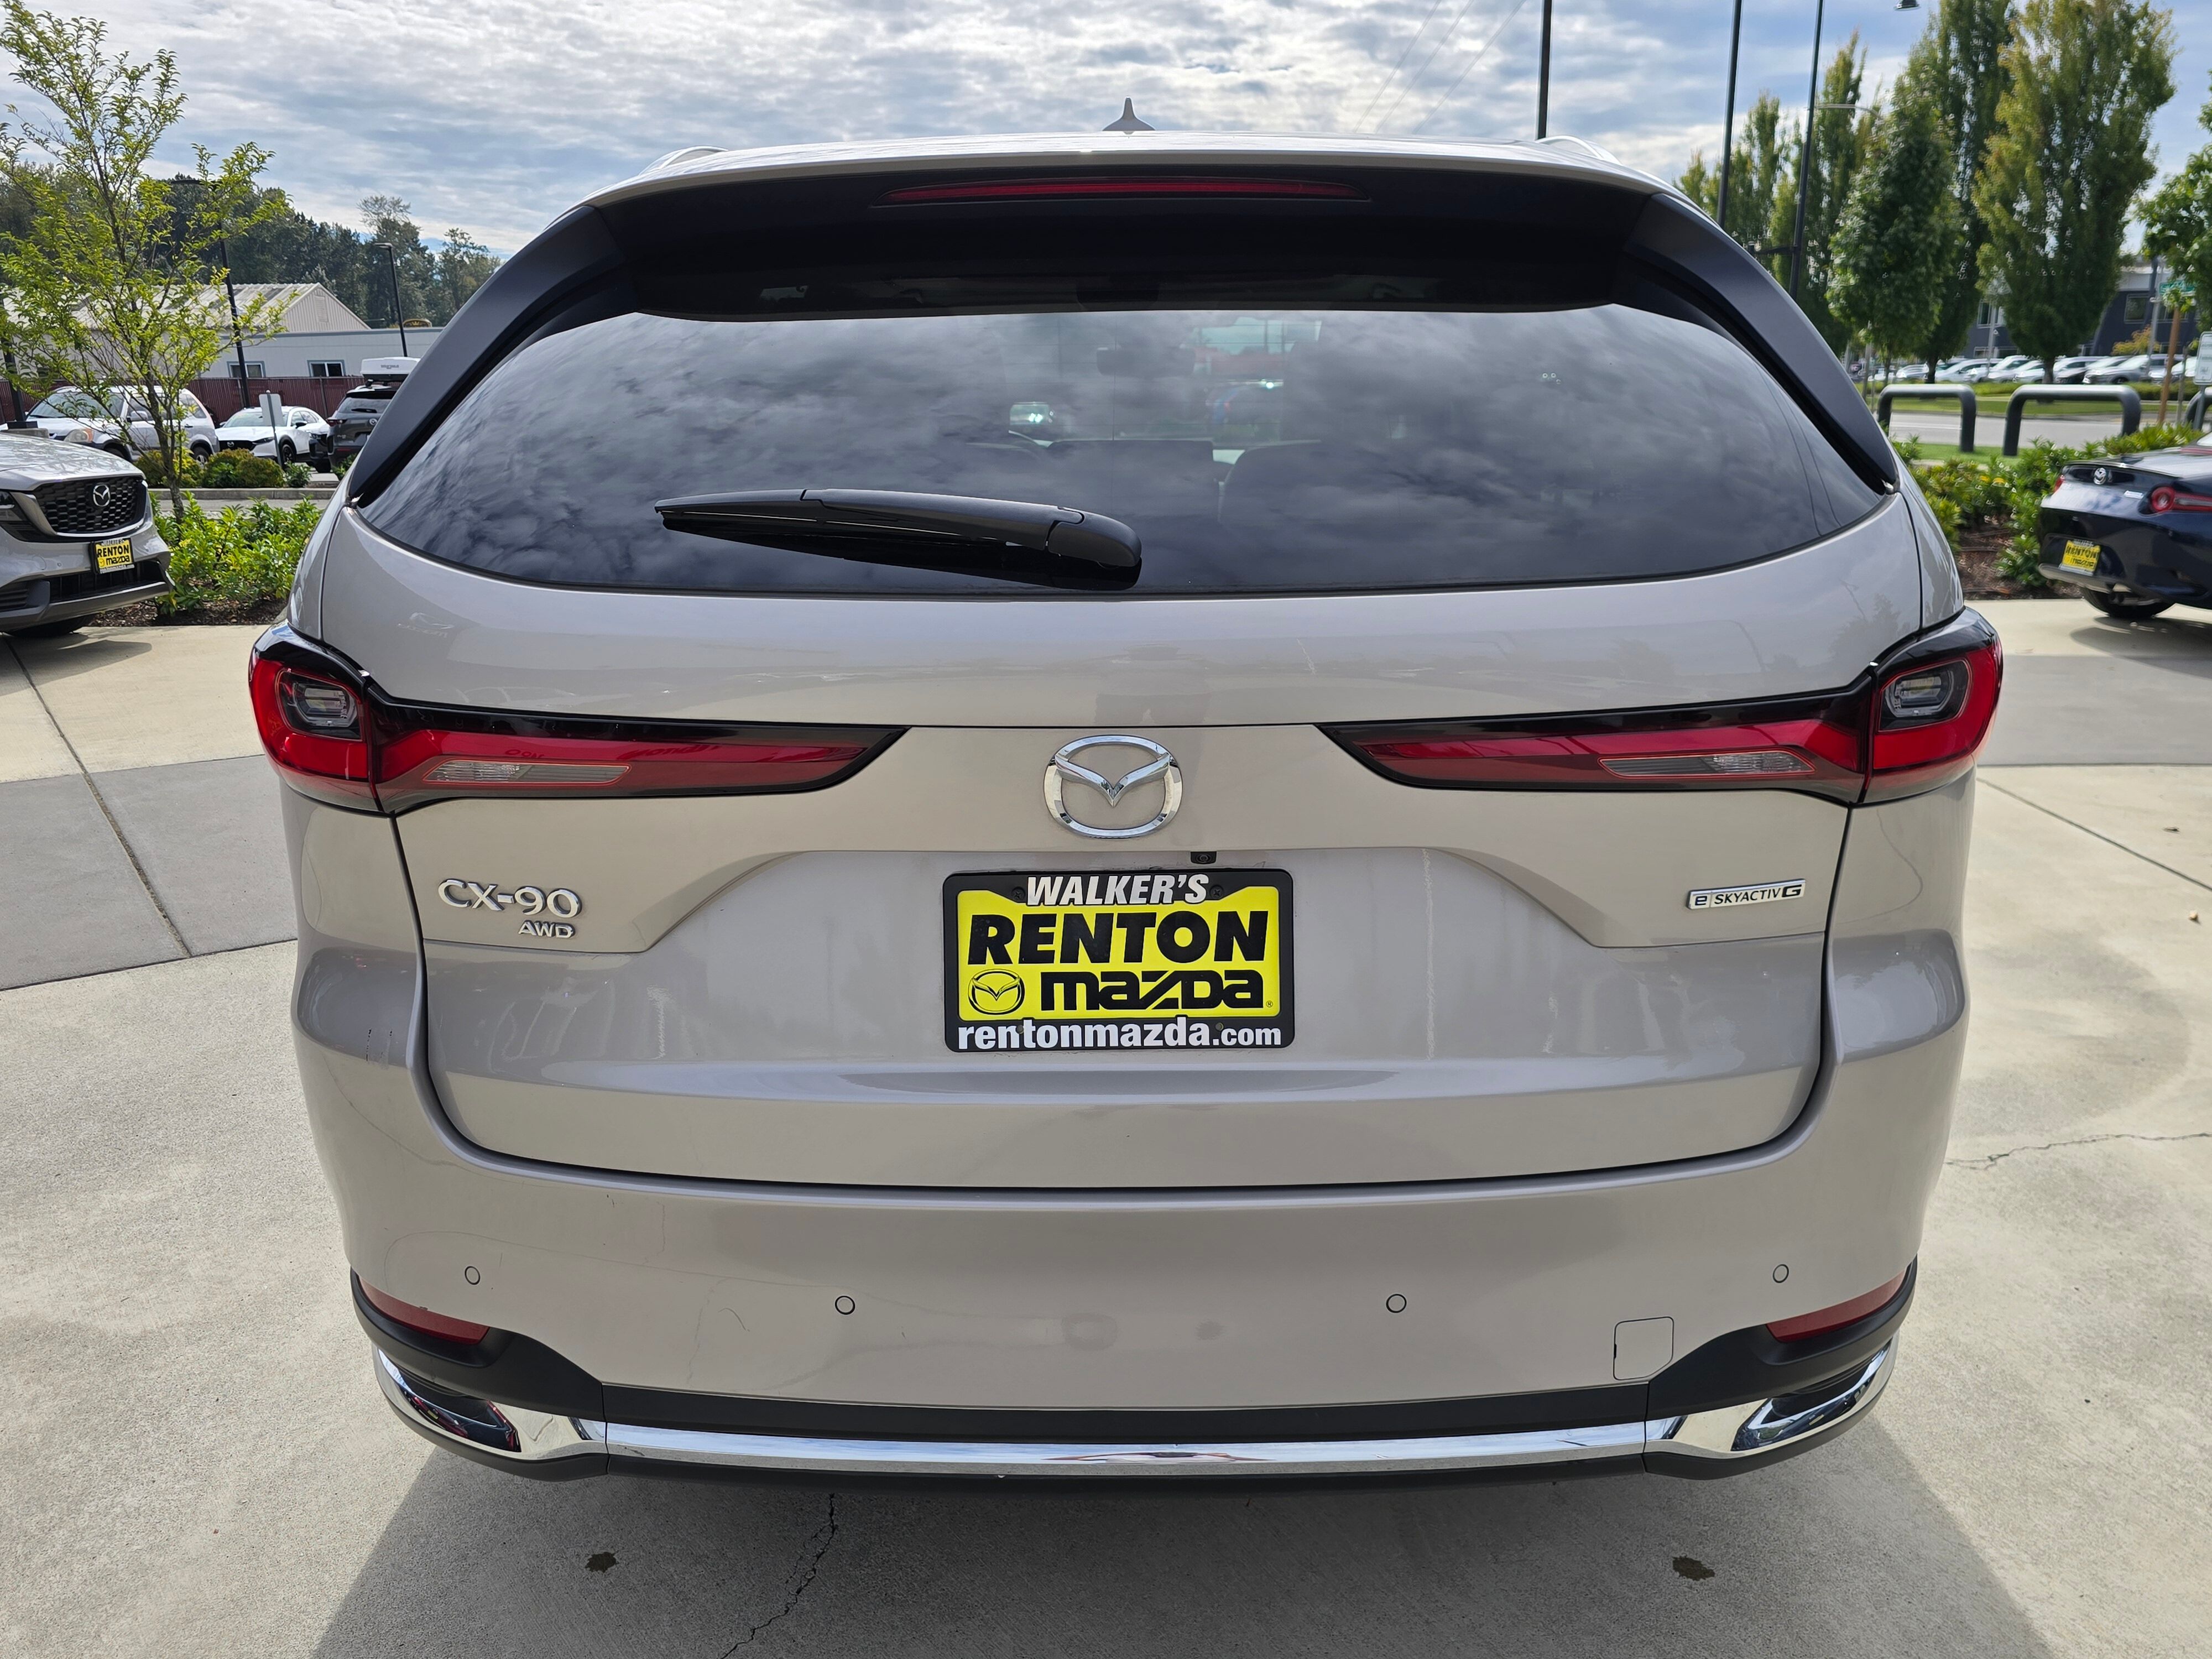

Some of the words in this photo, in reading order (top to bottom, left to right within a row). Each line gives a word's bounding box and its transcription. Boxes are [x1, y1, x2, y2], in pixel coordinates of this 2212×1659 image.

[97, 545, 129, 558] RENTON
[438, 878, 582, 918] CX-90
[1027, 873, 1209, 905] WALKER'S
[518, 920, 576, 938] AWD
[967, 910, 1269, 965] RENTON
[1040, 970, 1264, 1011] mazda
[958, 1018, 1281, 1050] rentonmazda.com
